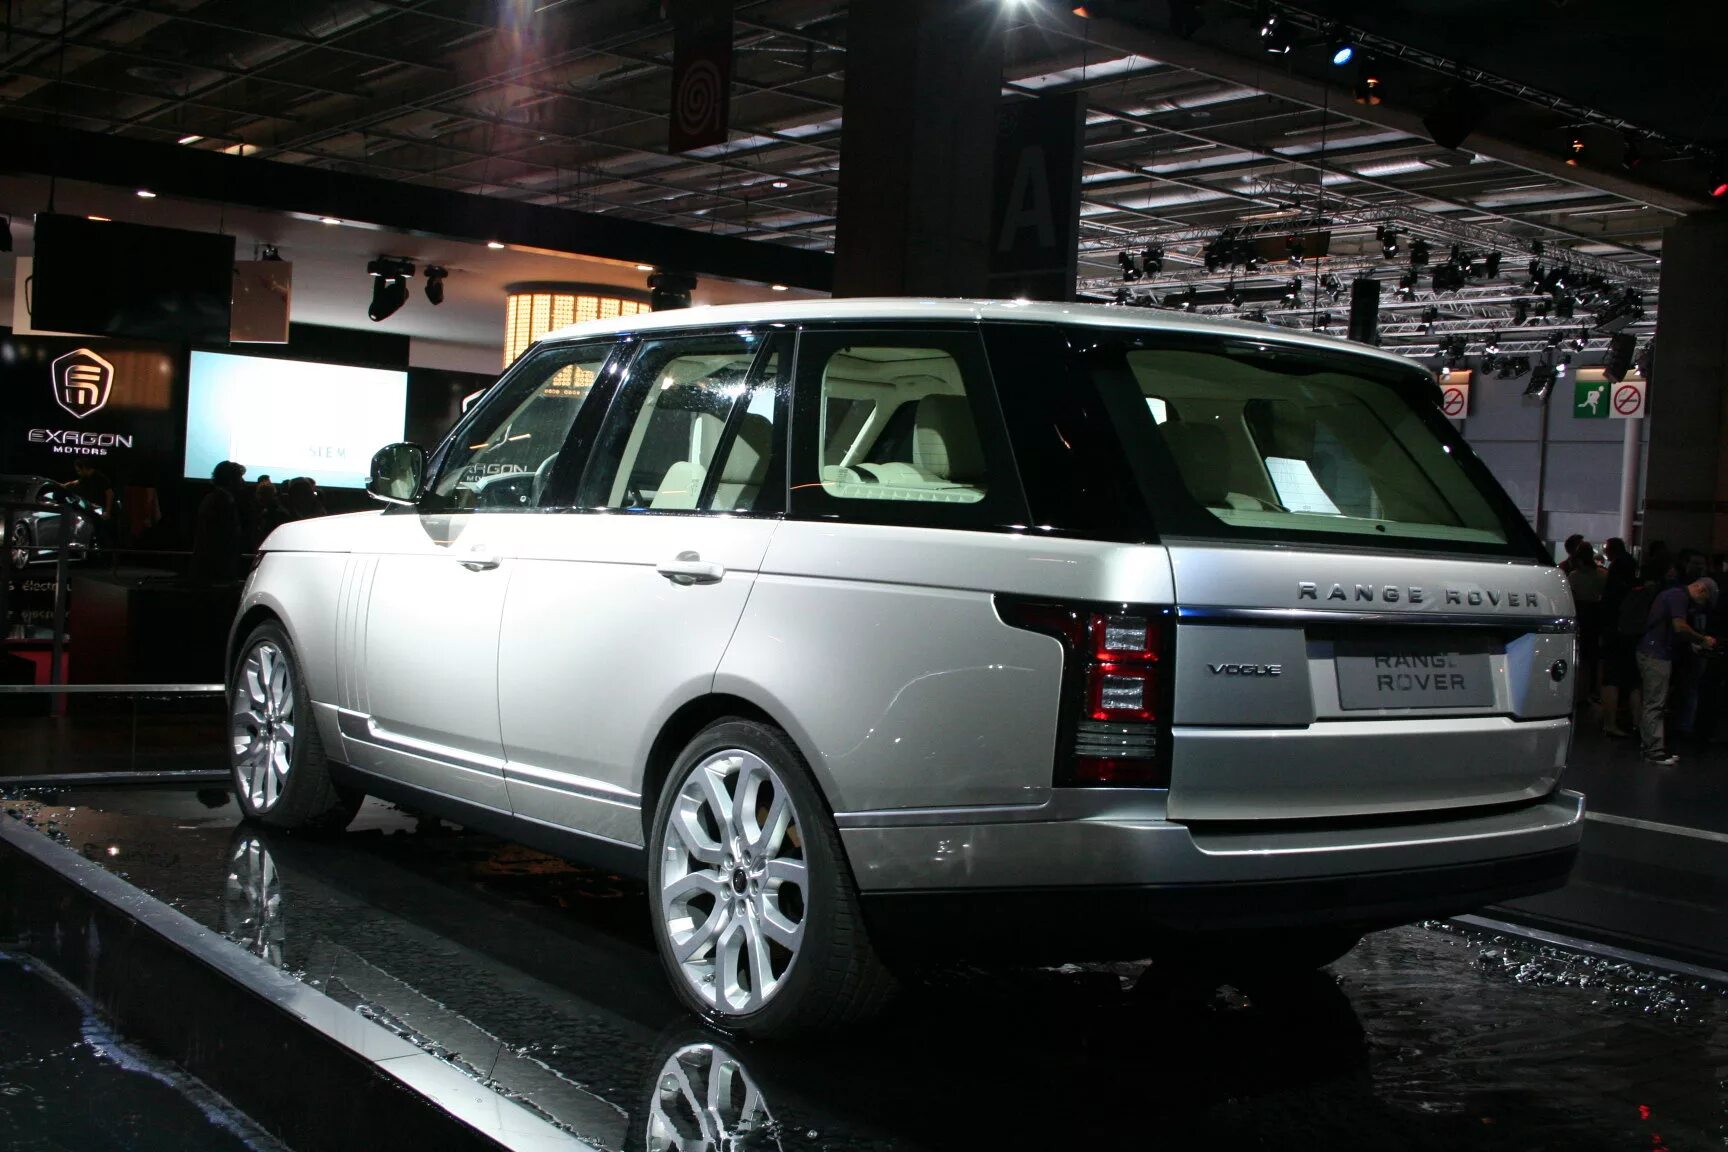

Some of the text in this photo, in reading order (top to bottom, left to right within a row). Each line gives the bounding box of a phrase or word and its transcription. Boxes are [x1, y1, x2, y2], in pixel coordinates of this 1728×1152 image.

[998, 146, 1057, 251] A
[28, 429, 133, 448] EXAGON
[53, 446, 108, 456] MOTORS
[1298, 581, 1539, 608] RANGE ROVER
[1206, 663, 1282, 677] VOGUE
[1376, 674, 1466, 691] ROVER
